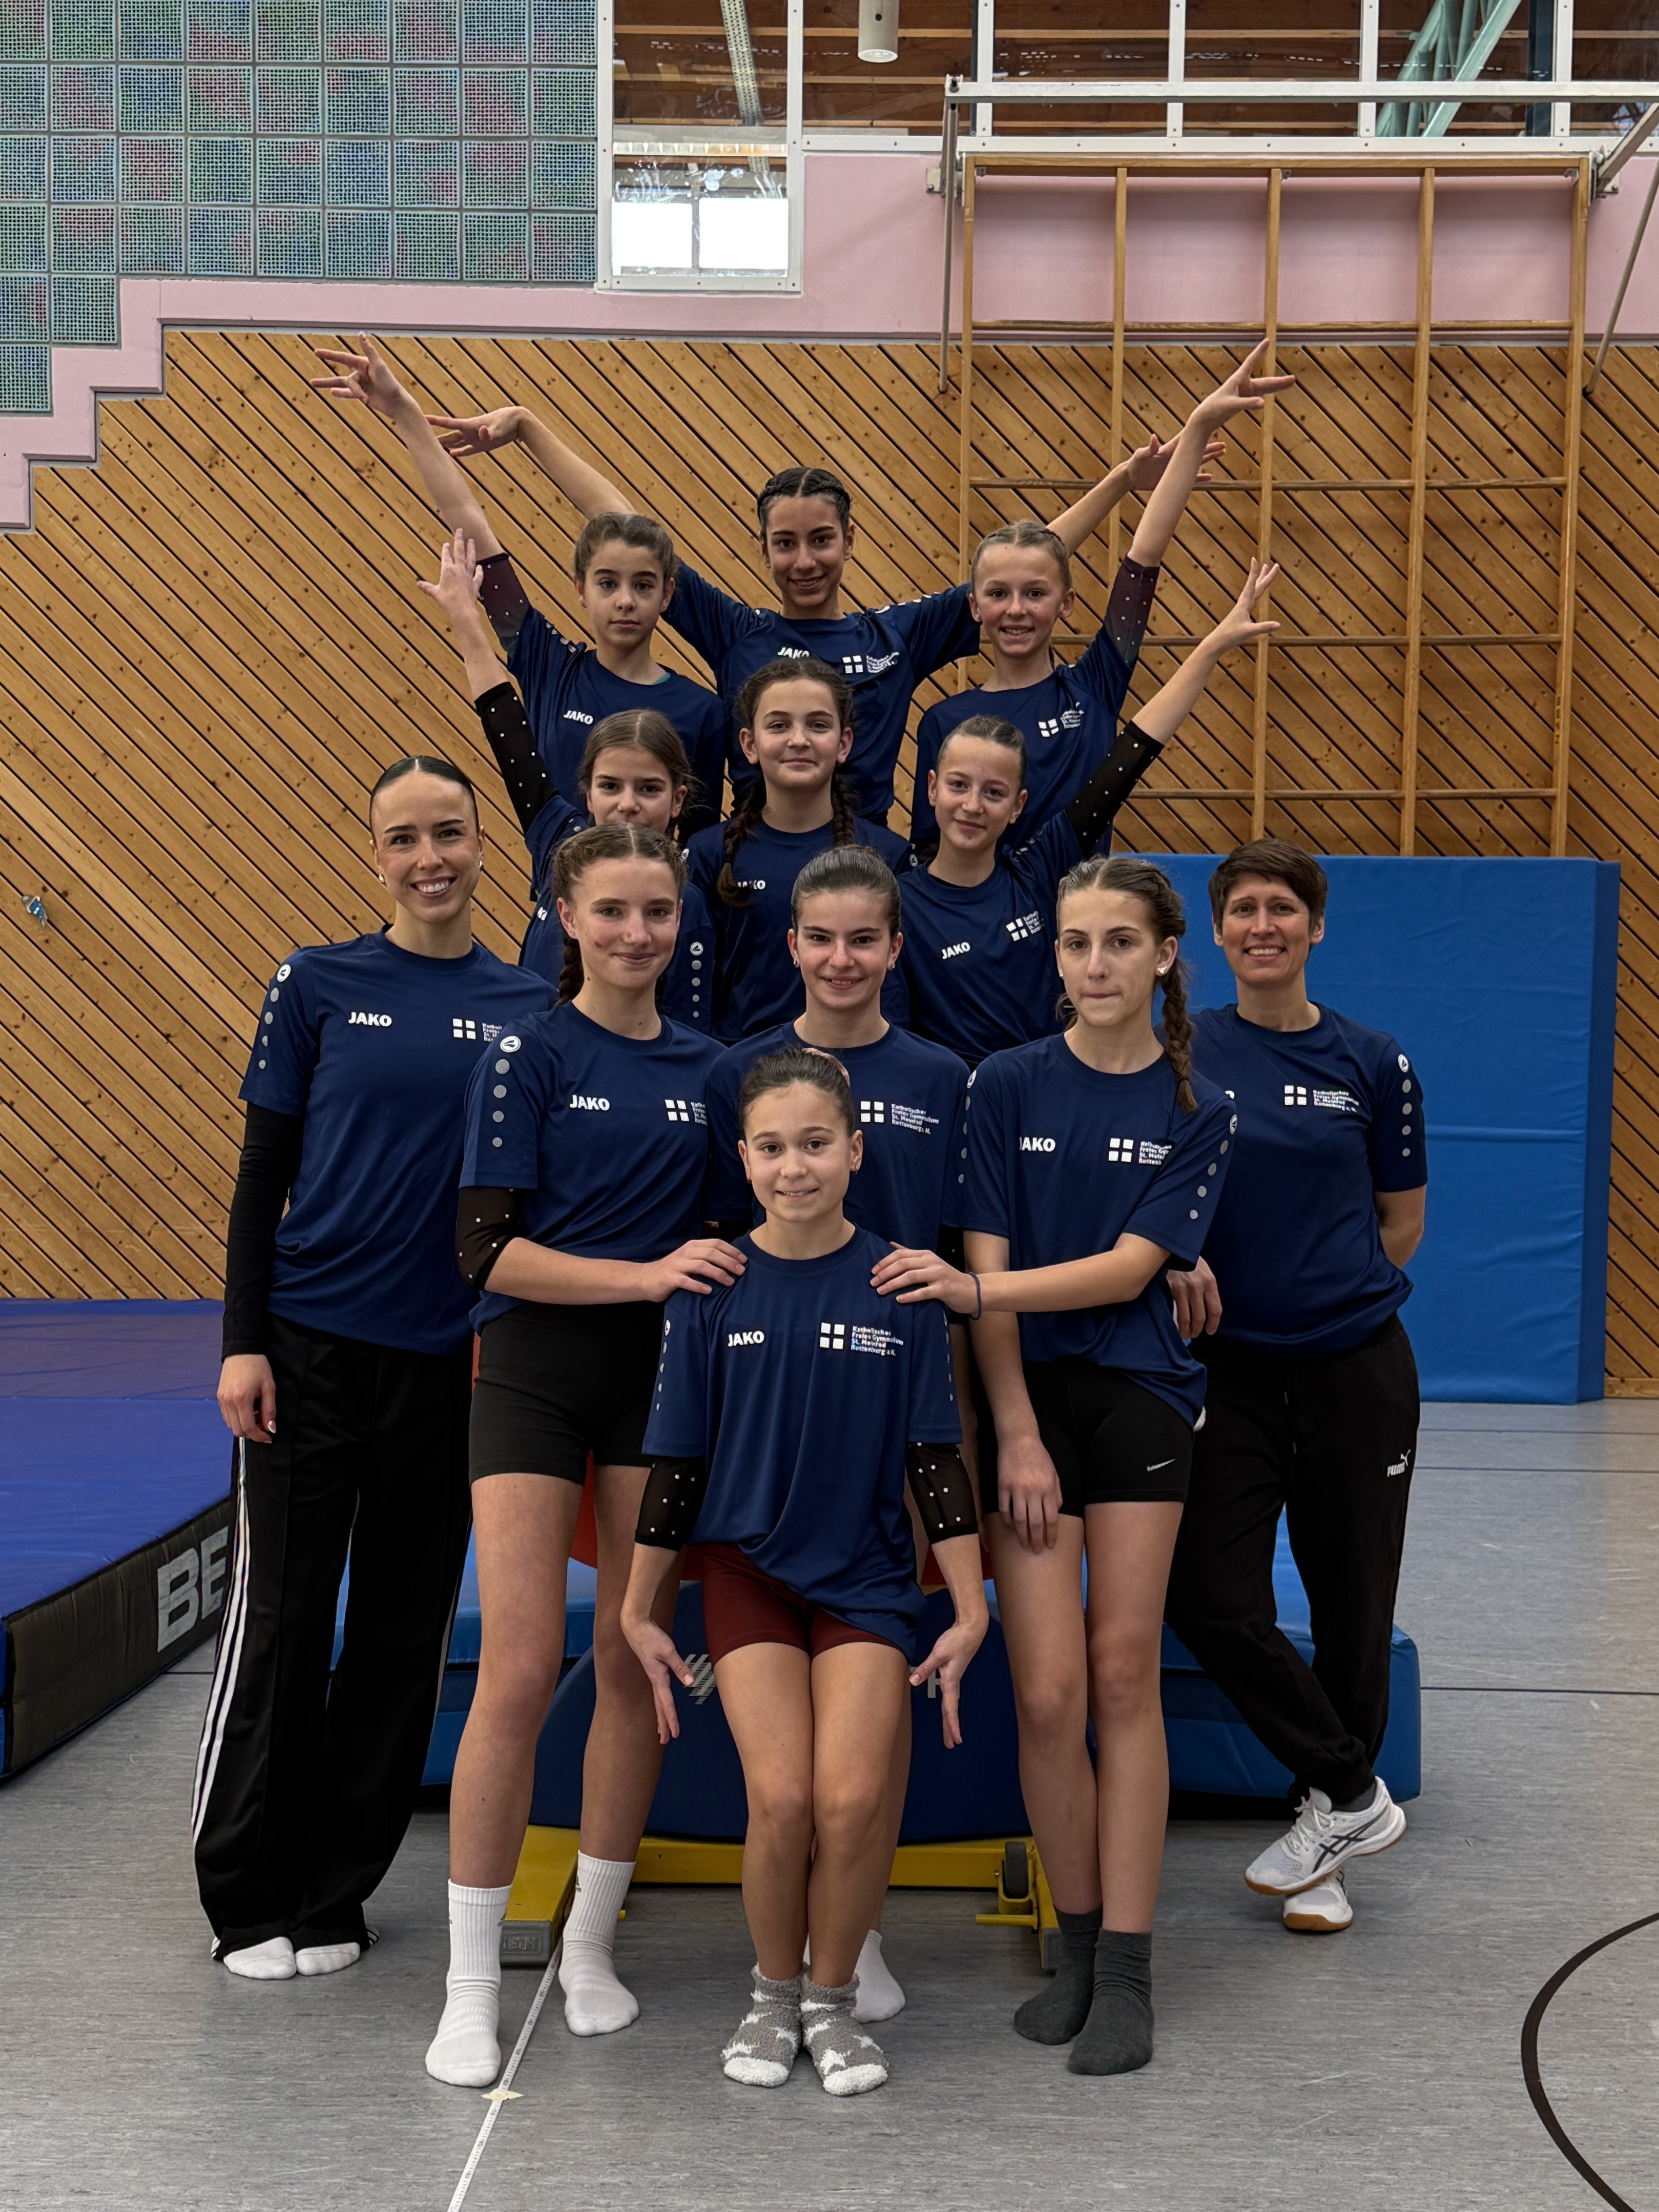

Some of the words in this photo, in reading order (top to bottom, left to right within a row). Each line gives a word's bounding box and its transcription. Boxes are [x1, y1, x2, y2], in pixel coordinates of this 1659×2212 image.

[563, 710, 593, 725] JAKO
[941, 942, 970, 960] JAKO
[348, 1011, 392, 1027] JAKO
[569, 1094, 610, 1111] JAKO
[728, 1330, 764, 1347] JAKO
